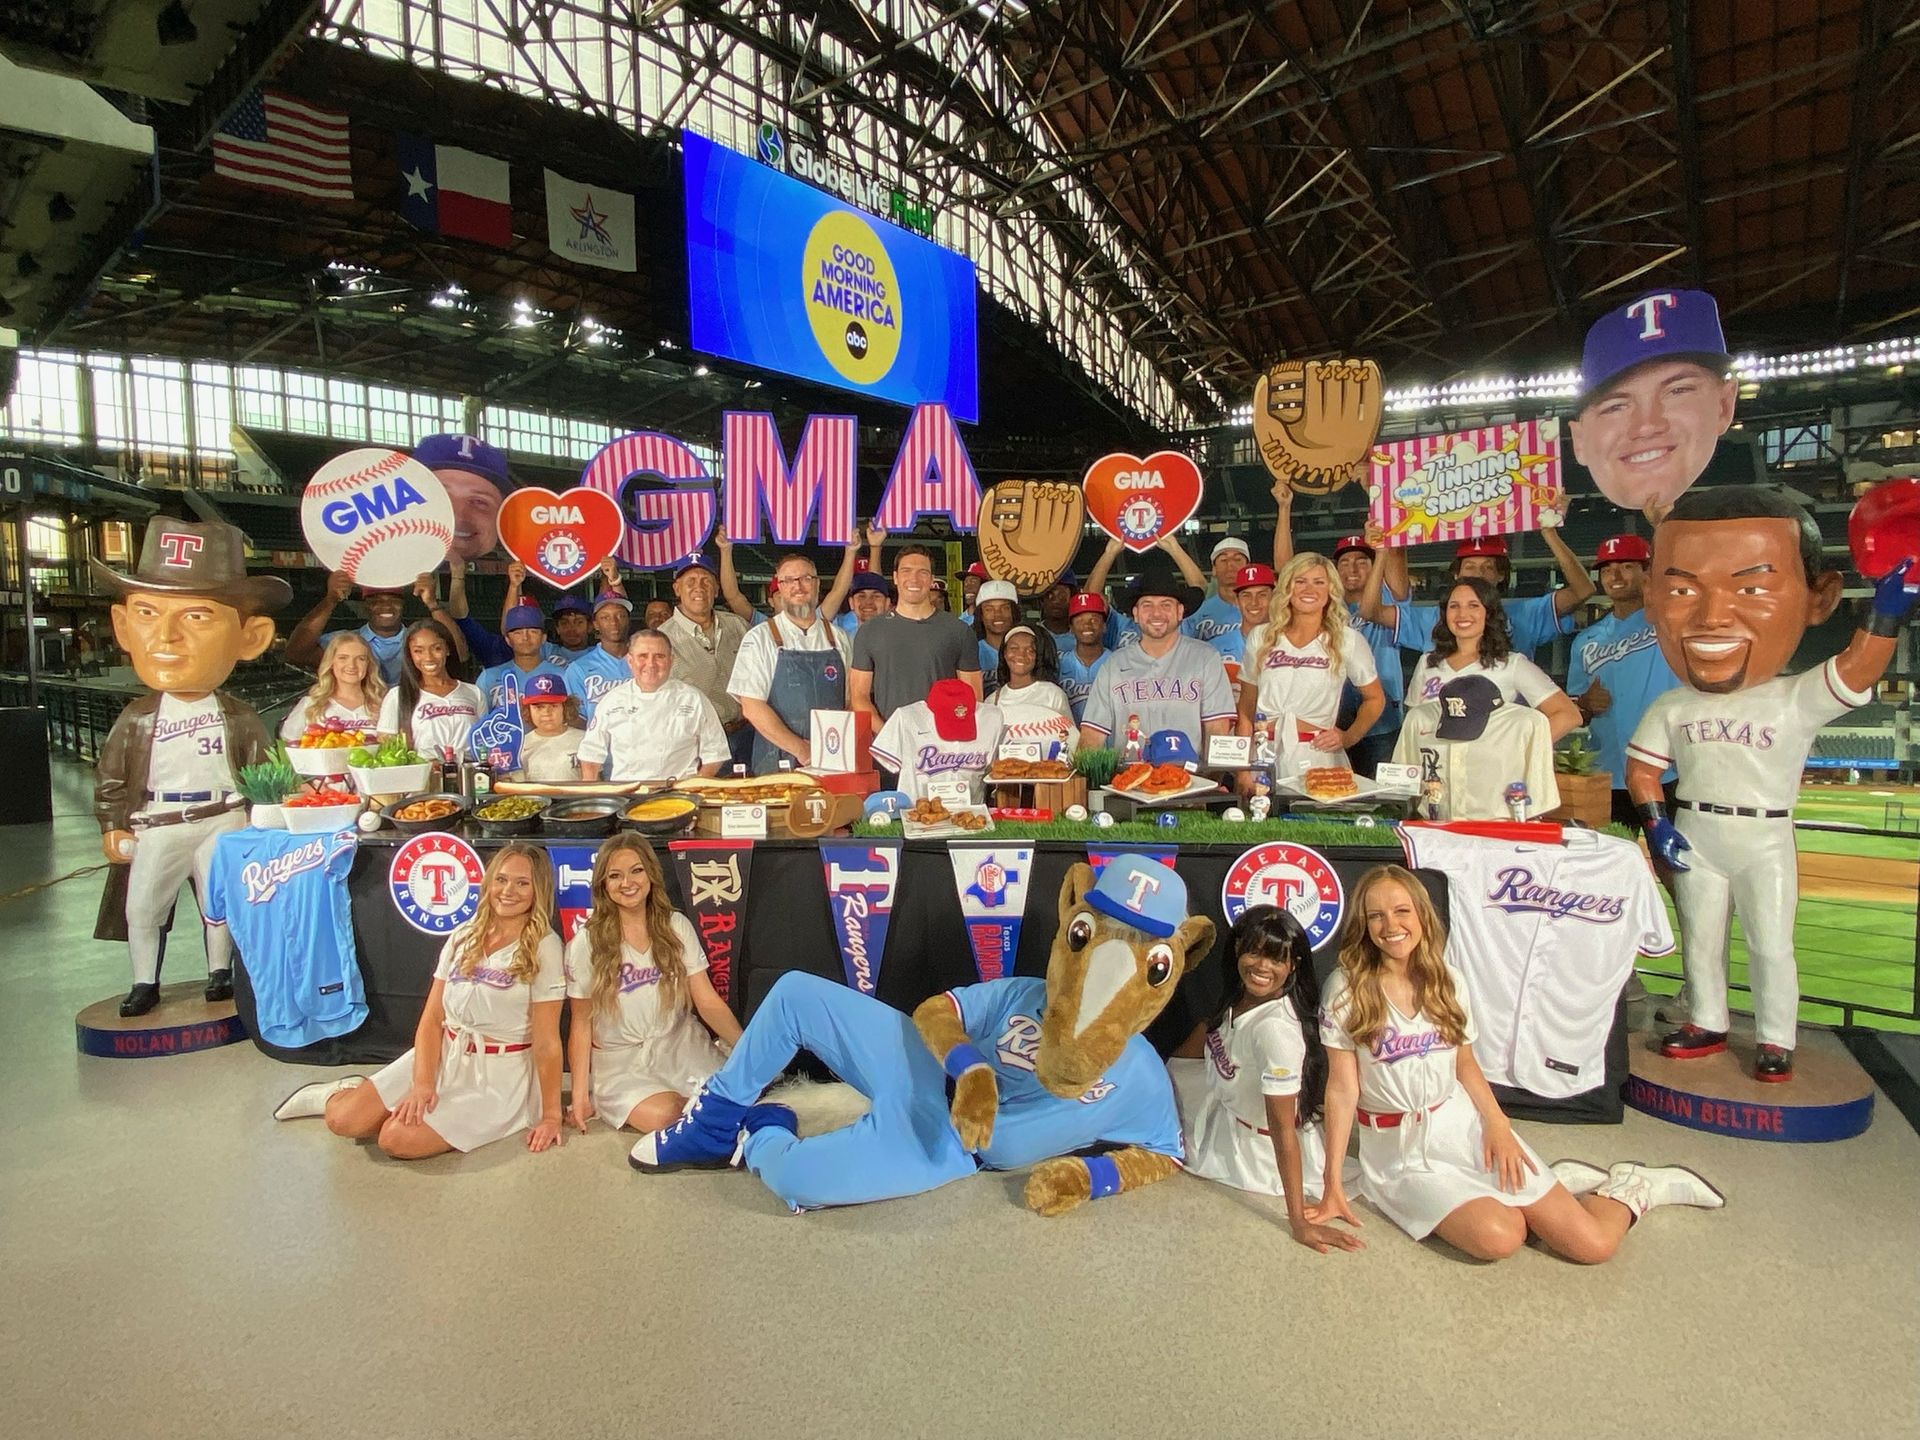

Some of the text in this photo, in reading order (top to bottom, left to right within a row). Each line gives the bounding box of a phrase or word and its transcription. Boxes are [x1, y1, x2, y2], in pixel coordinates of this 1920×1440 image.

[565, 239, 619, 259] ARLINGTON
[832, 243, 876, 276] GOOD
[821, 259, 886, 300] MORNING
[812, 278, 896, 330] AMERICA
[1627, 293, 1676, 341] T
[846, 331, 867, 350] abc
[1113, 470, 1166, 490] GMA
[1422, 453, 1457, 482] 7TH
[1437, 450, 1520, 493] INNING
[321, 476, 427, 536] GMA
[1398, 487, 1424, 497] GMA
[1424, 474, 1514, 517] SNACKS
[530, 505, 586, 525] GMA
[160, 532, 204, 568] T
[1112, 678, 1201, 705] TEXAS
[153, 711, 224, 743] Rangers
[1680, 718, 1776, 750] TEXAS
[197, 736, 224, 756] 34
[914, 743, 989, 777] Rangers
[403, 839, 471, 864] TEXAS
[1241, 849, 1325, 879] TEXAS
[398, 889, 479, 928] RANGERS
[1484, 867, 1629, 925] Rangers
[840, 892, 874, 992] Rangers
[113, 1033, 176, 1053] NOLAN
